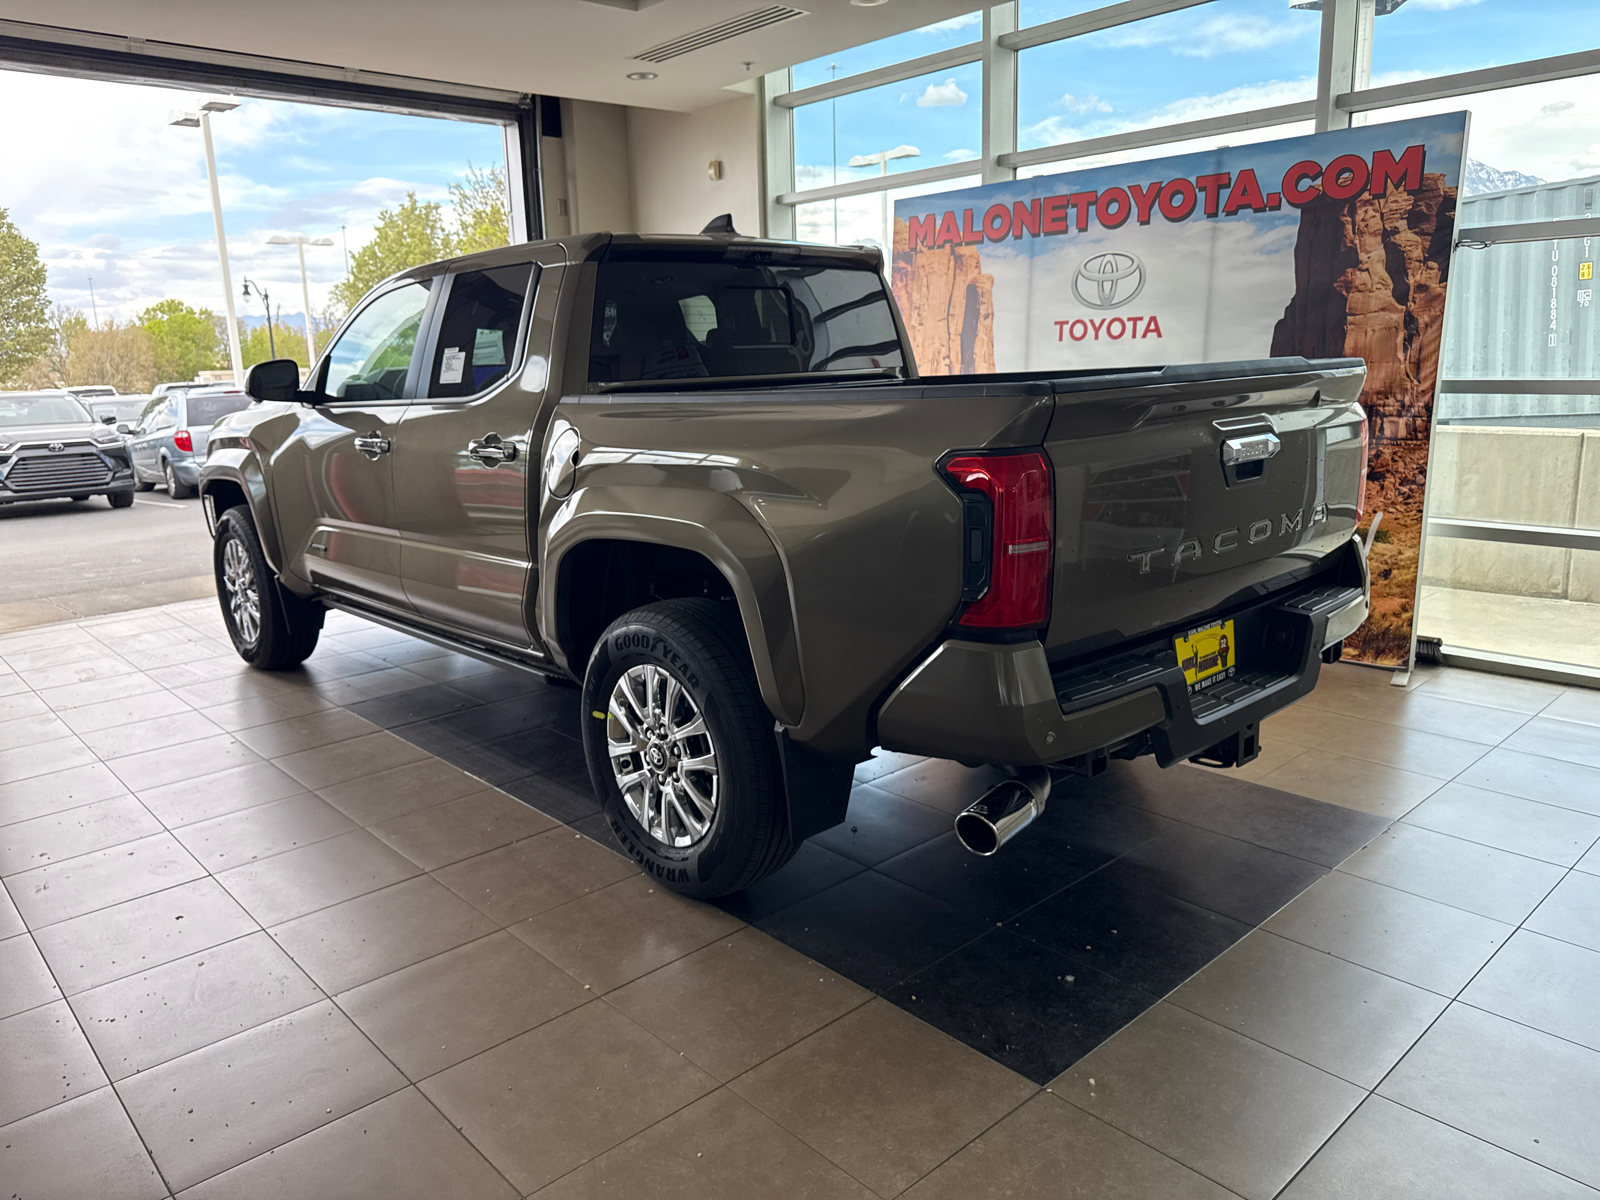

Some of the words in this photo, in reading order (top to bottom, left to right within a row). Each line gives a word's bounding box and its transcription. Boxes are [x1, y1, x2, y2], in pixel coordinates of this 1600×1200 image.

[908, 144, 1426, 250] MALONETOYOTA.COM
[1054, 316, 1162, 342] TOYOTA
[1550, 265, 1558, 330] 081884
[1127, 502, 1328, 574] TACOMA
[1220, 639, 1227, 648] 32
[1217, 671, 1226, 681] EASY
[610, 819, 691, 883] WRANGLER
